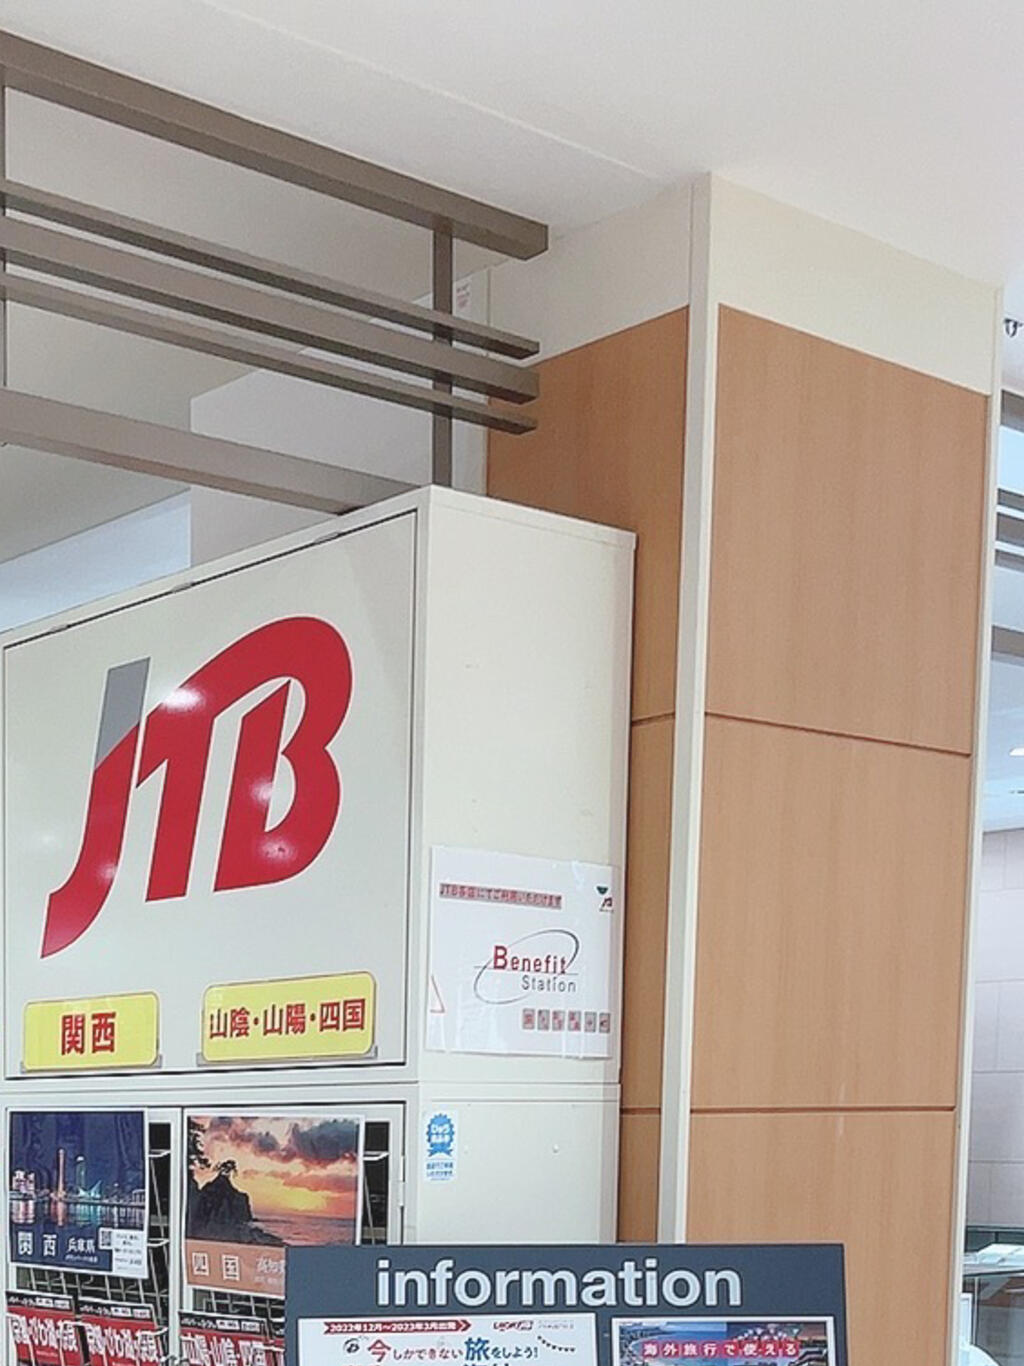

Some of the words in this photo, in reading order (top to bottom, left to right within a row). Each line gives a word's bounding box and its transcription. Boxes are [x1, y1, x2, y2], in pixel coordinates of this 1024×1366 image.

[41, 616, 353, 959] JTB
[493, 945, 566, 974] Benefit
[521, 974, 576, 993] Station
[61, 1012, 117, 1056] 関西
[209, 998, 366, 1039] 山陰・山陽・四国
[377, 1258, 741, 1307] information
[367, 1337, 538, 1361] 今しかできない旅をしよう!
[644, 1343, 797, 1355] 海外旅行で使える
